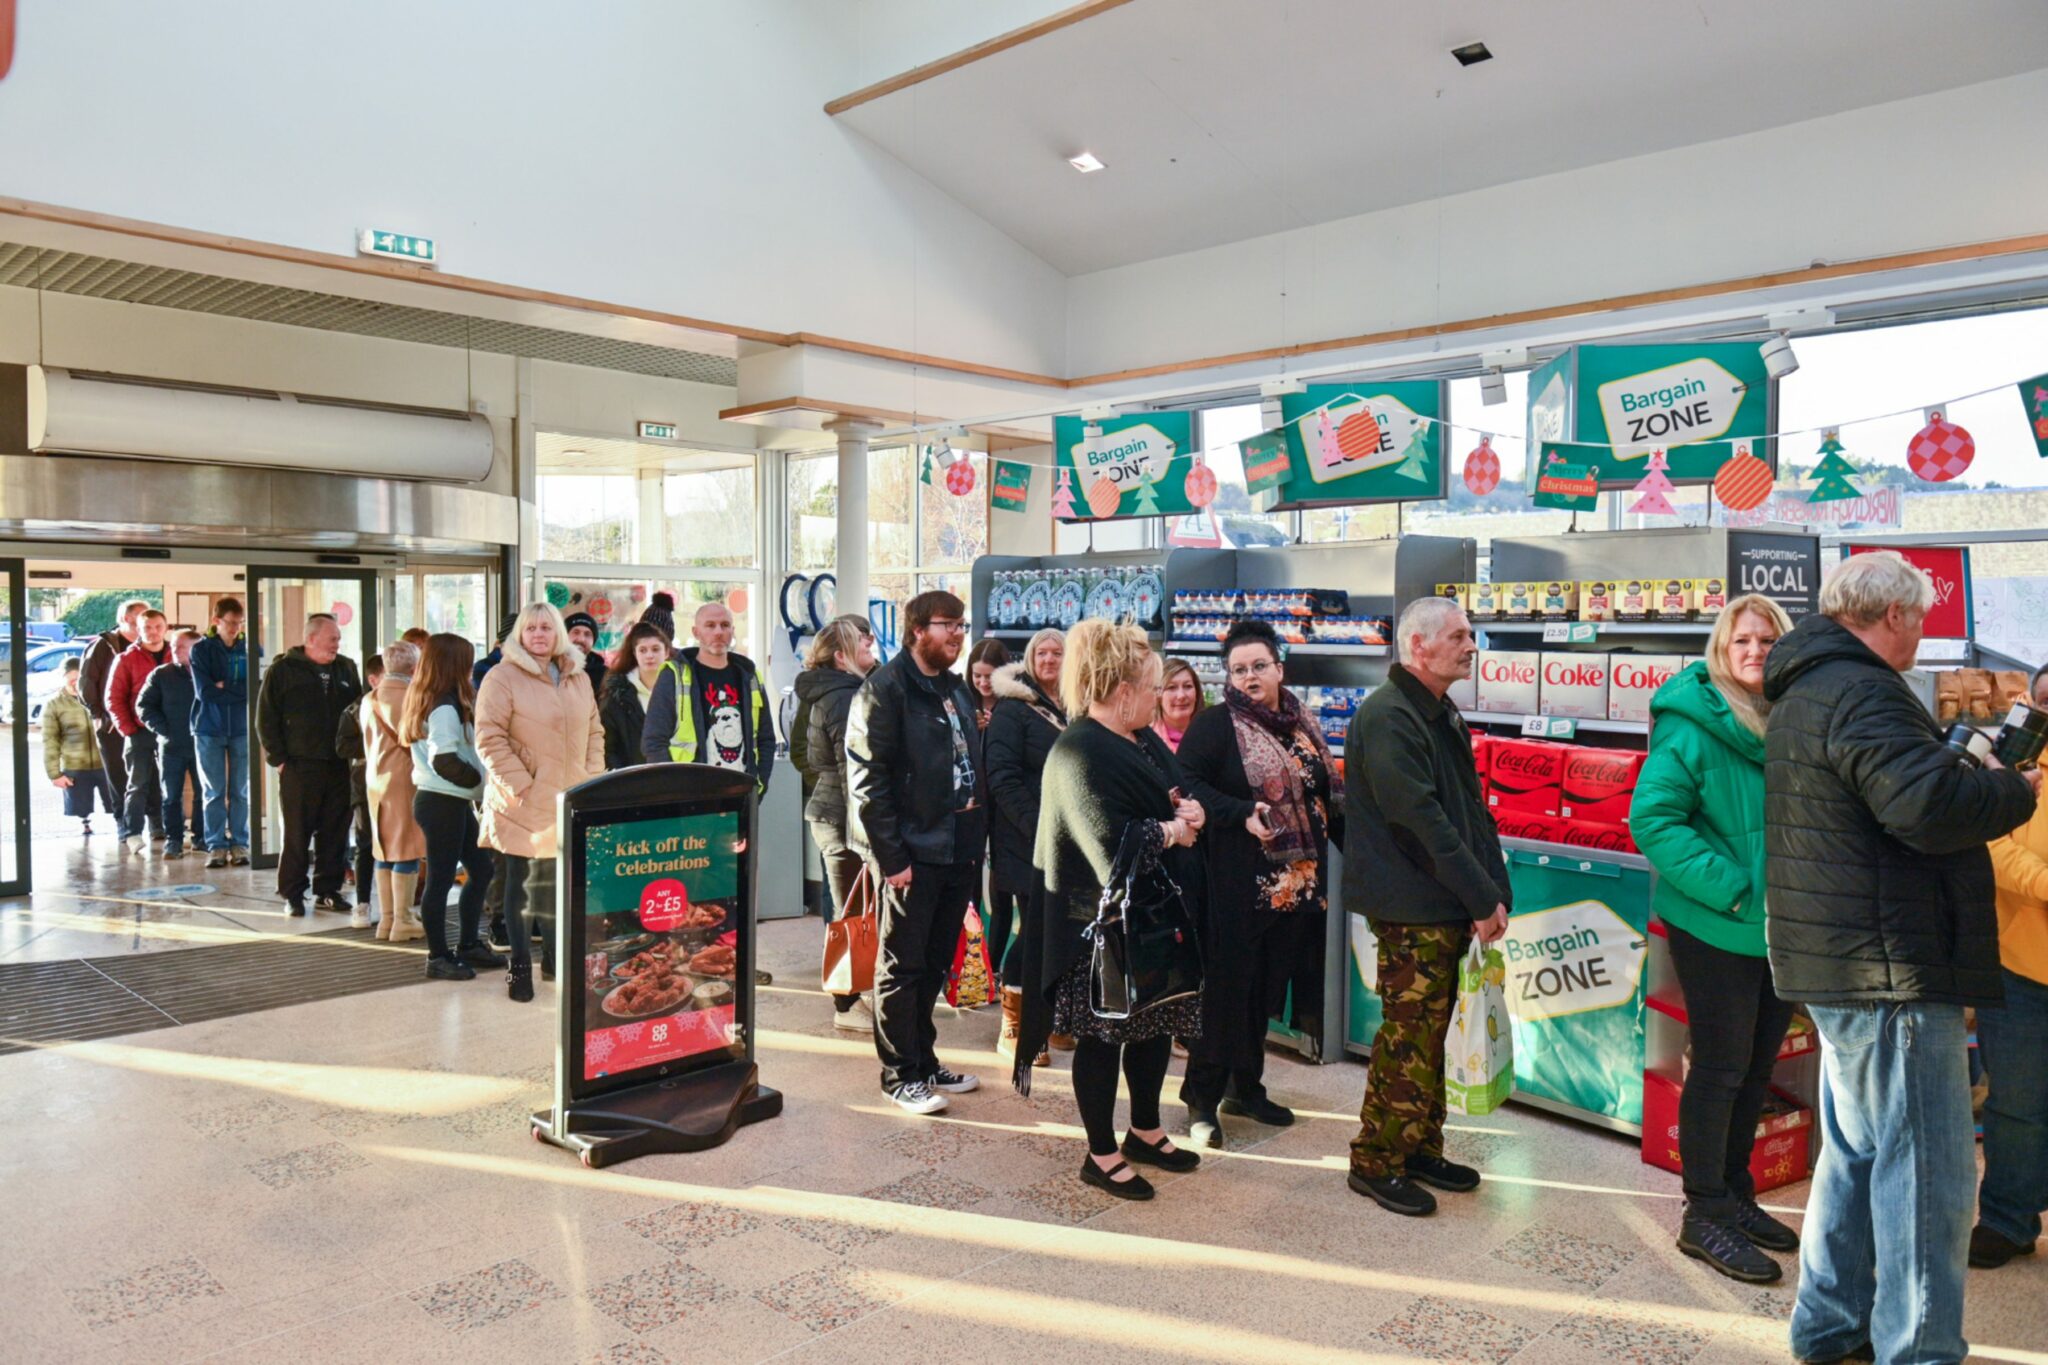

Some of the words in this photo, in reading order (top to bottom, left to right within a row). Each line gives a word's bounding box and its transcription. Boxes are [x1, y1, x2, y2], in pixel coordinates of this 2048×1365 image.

[1620, 378, 1706, 413] Bargain
[1627, 401, 1712, 443] ZONE
[1087, 438, 1148, 466] Bargain
[1540, 480, 1595, 493] Christmas
[1751, 549, 1799, 561] SUPPORTING
[1741, 564, 1809, 592] LOCAL
[1546, 628, 1568, 637] £2.50
[1481, 660, 1535, 684] Coke
[1544, 662, 1604, 687] Coke
[1529, 720, 1543, 731] £8
[615, 839, 651, 857] Kick
[655, 836, 680, 854] off
[683, 835, 706, 851] the
[614, 855, 710, 877] Celebrations
[656, 889, 671, 898] ANY
[645, 899, 655, 915] 2
[663, 896, 681, 913] £5
[1505, 925, 1600, 961] Bargain
[1515, 957, 1612, 1000] ZONE
